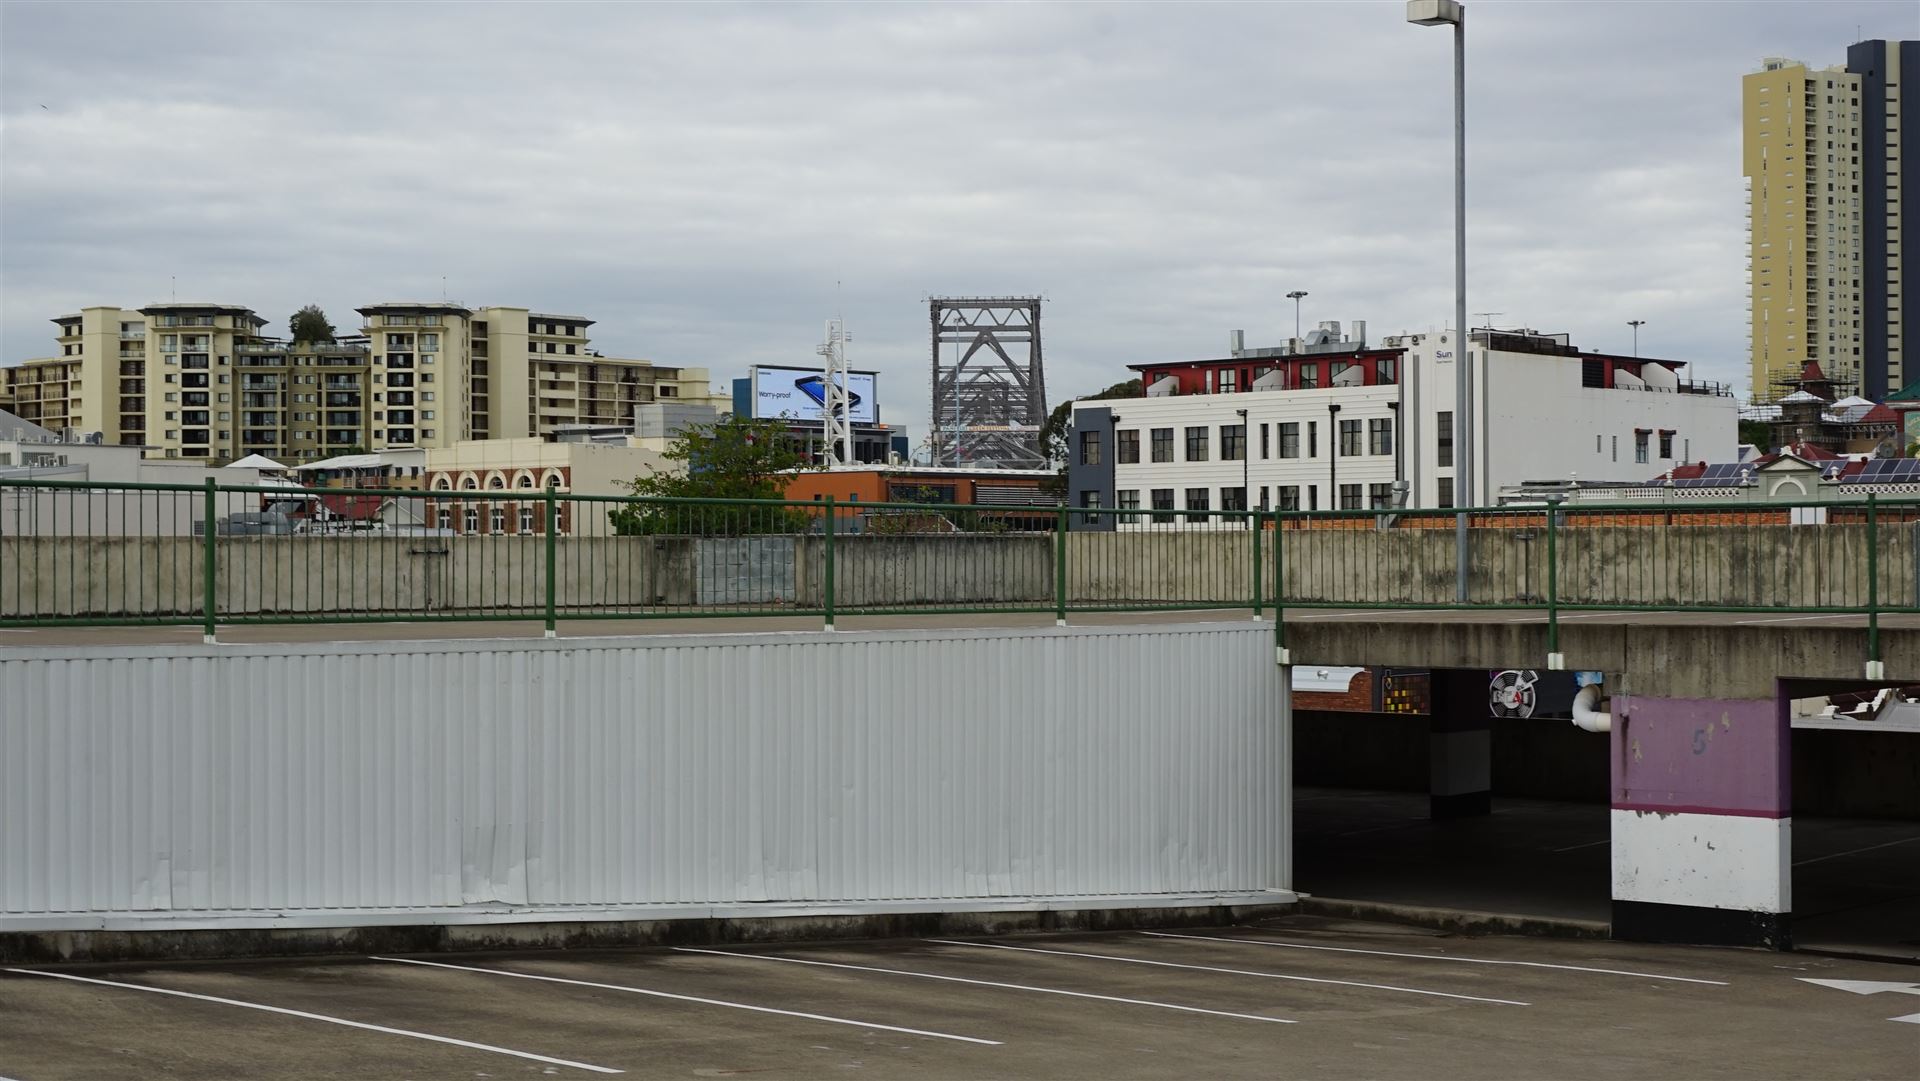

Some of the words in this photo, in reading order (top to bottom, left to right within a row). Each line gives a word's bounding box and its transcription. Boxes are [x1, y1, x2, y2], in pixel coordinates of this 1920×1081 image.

[1436, 350, 1453, 359] Sun
[758, 391, 792, 399] Worry-proof
[1691, 729, 1707, 756] 5
